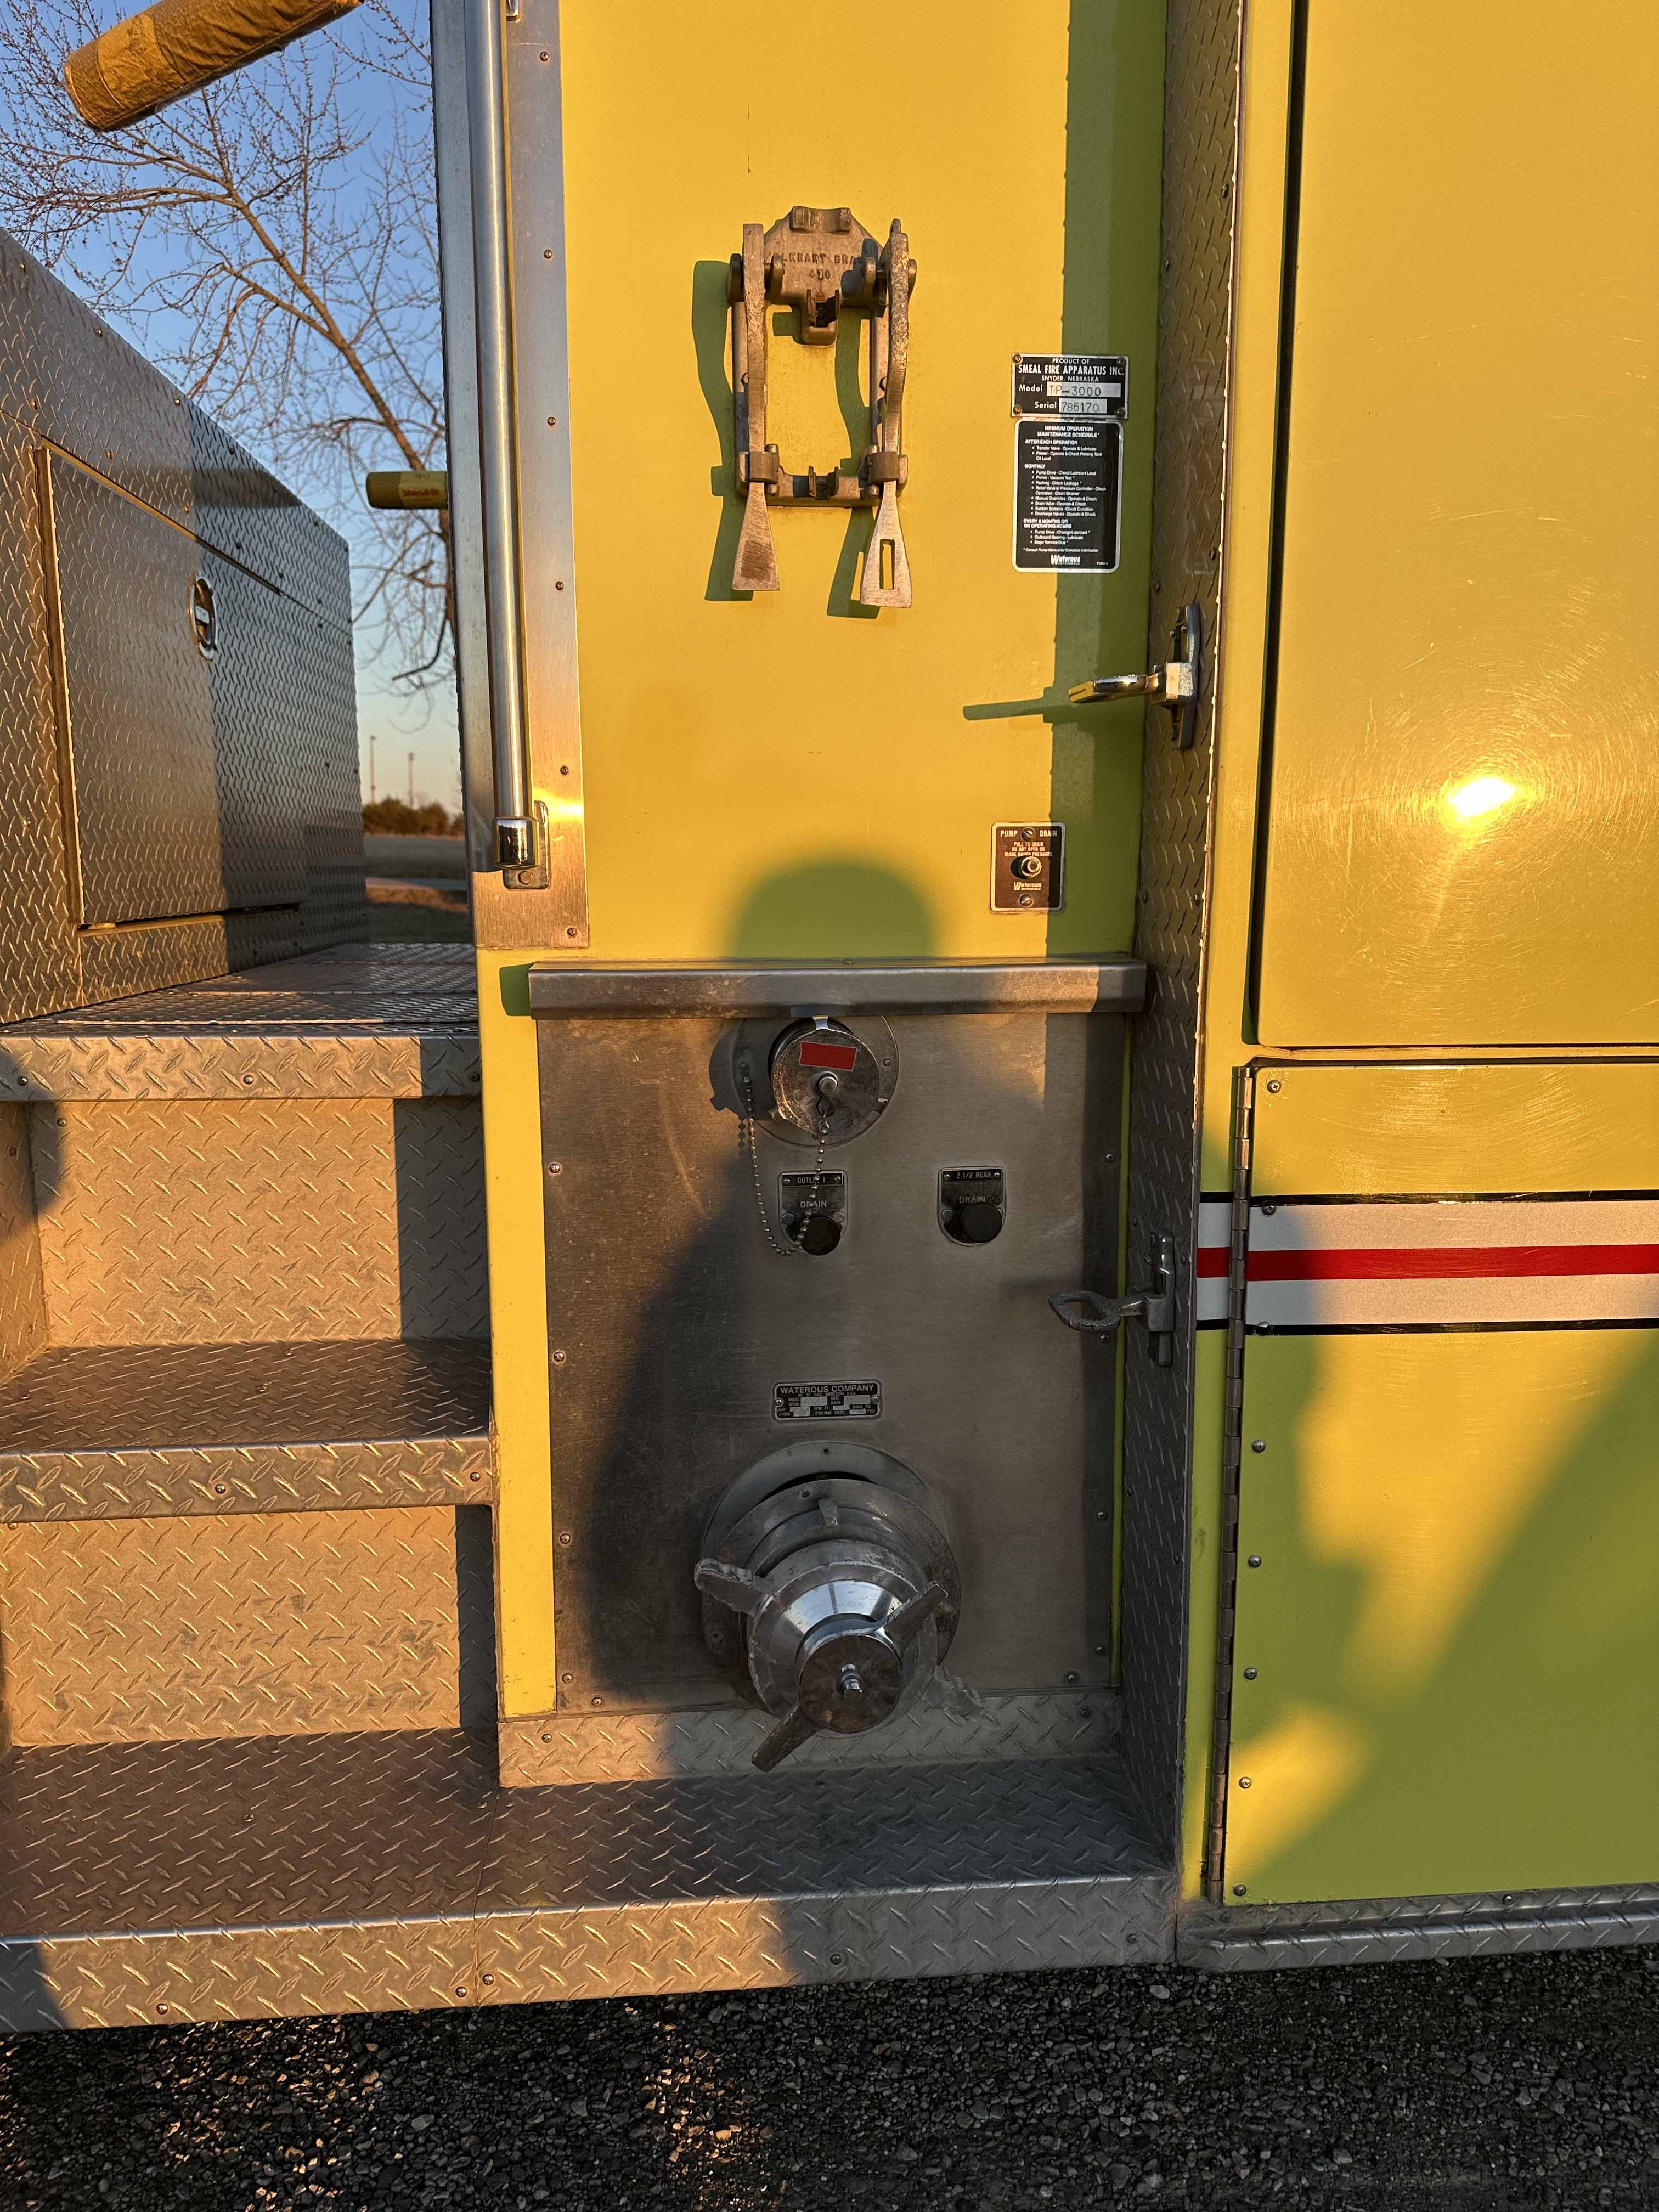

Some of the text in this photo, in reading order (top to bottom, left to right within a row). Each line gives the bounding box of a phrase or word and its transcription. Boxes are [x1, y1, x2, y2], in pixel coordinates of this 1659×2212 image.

[774, 253, 826, 264] LKHART
[1018, 364, 1125, 376] SMEAL FIRE APPARATUS INC.
[1048, 386, 1101, 396] TP-3000
[1062, 402, 1099, 412] 786170
[1051, 554, 1081, 565] Waterous
[1014, 882, 1042, 891] Waterous
[780, 1384, 874, 1394] WATEROUS COMPANY
